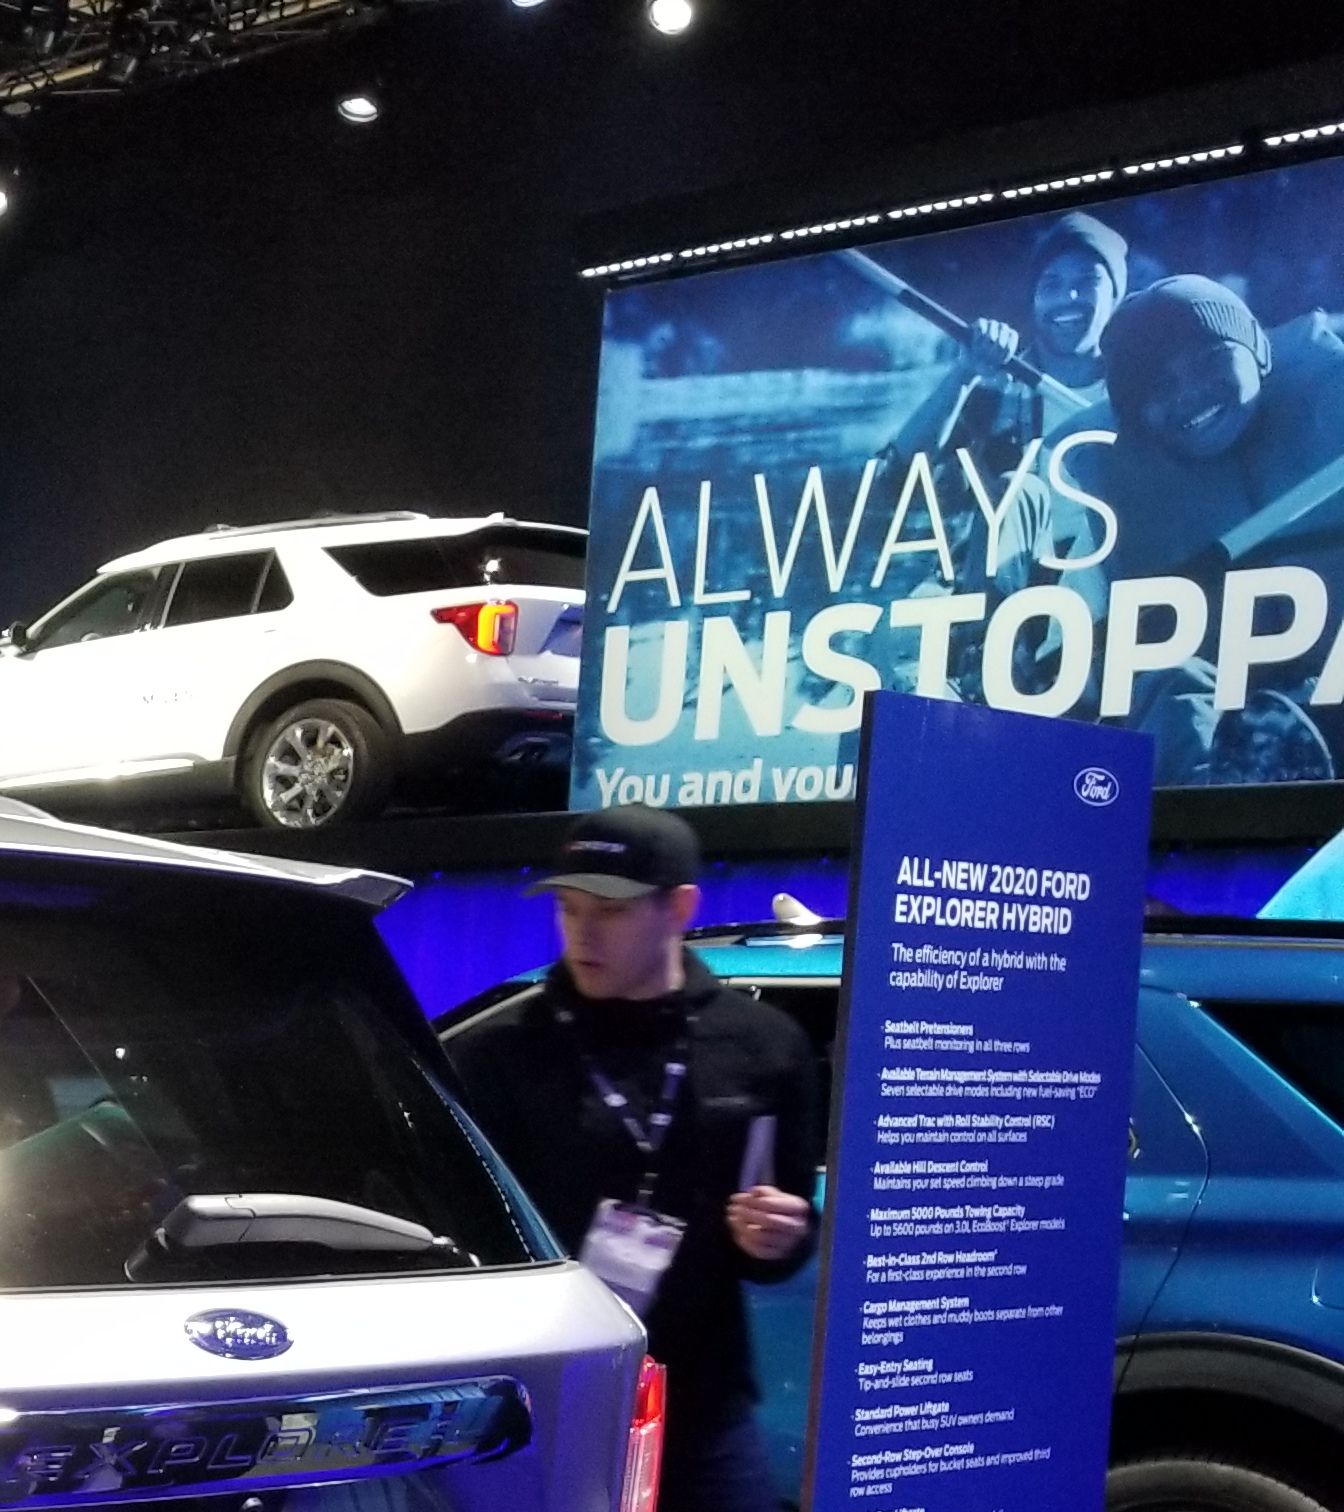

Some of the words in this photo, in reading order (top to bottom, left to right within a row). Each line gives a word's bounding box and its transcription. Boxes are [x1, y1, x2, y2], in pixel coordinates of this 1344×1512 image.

[607, 430, 1118, 613] ALWAYS
[598, 564, 1344, 747] UNSTOPP
[594, 765, 670, 807] You
[677, 757, 763, 804] and
[772, 763, 857, 802] you
[1081, 771, 1113, 801] Ford
[897, 855, 988, 893] ALL-NEW
[989, 864, 1038, 897] 2020
[1040, 869, 1091, 901] FORD
[894, 893, 1000, 931] EXPLORER
[1002, 902, 1072, 935] HYBRID
[892, 942, 913, 963] The
[914, 944, 968, 969] efficiency
[968, 947, 981, 967] of
[981, 951, 990, 967] a
[991, 948, 1024, 971] hybrid
[1025, 951, 1048, 971] with
[1049, 952, 1067, 972] the
[889, 968, 944, 991] capability
[945, 970, 958, 988] of
[959, 971, 1004, 993] Explorer
[885, 1020, 919, 1034] Seatbelt
[880, 1083, 905, 1097] Seven
[877, 1115, 918, 1129] Advanced
[918, 1115, 936, 1128] Trac
[937, 1115, 955, 1128] with
[955, 1115, 971, 1128] Roll
[972, 1115, 1004, 1130] Stability
[1004, 1115, 1032, 1128] Control
[877, 1130, 900, 1145] Helps
[900, 1132, 915, 1146] you
[915, 1131, 949, 1143] maintain
[949, 1130, 976, 1143] control
[977, 1132, 987, 1143] on
[987, 1130, 997, 1142] all
[997, 1130, 1028, 1142] surfaces
[873, 1161, 912, 1175] Available
[912, 1161, 926, 1174] Hill
[926, 1160, 959, 1173] Descent
[959, 1159, 989, 1173] Control
[870, 1207, 911, 1221] Maximum
[910, 1207, 934, 1220] 5000
[934, 1206, 964, 1219] Pounds
[964, 1205, 992, 1220] Towing
[992, 1204, 1026, 1219] Capacity
[863, 1300, 888, 1315] Cargo
[888, 1298, 940, 1314] Management
[940, 1296, 970, 1311] System
[863, 1316, 888, 1330] Keeps
[887, 1315, 903, 1328] wet
[903, 1313, 932, 1327] clothes
[932, 1312, 948, 1325] and
[948, 1310, 973, 1325] muddy
[973, 1309, 995, 1322] boots
[862, 1331, 904, 1346] belongings
[858, 1360, 902, 1377] Easy-Entry
[902, 1357, 934, 1373] Seating
[858, 1376, 912, 1392] Tip-and-slide
[911, 1371, 938, 1386] second
[938, 1372, 954, 1384] row
[953, 1369, 974, 1382] seats
[854, 1405, 894, 1421] Standard
[894, 1403, 919, 1418] Power
[919, 1400, 950, 1417] Liftgate
[854, 1420, 904, 1438] Convenience
[904, 1418, 922, 1432] that
[922, 1417, 939, 1432] busy
[939, 1414, 957, 1428] SUV
[851, 1449, 902, 1467] Second-Row
[902, 1445, 943, 1461] Step-Over
[943, 1441, 975, 1458] Console
[851, 1466, 885, 1483] Provides
[885, 1461, 928, 1479] cupholders
[928, 1459, 940, 1473] for
[940, 1456, 965, 1472] bucket
[965, 1455, 985, 1469] seats
[985, 1452, 1000, 1467] and
[849, 1485, 865, 1498] row
[865, 1482, 893, 1496] access
